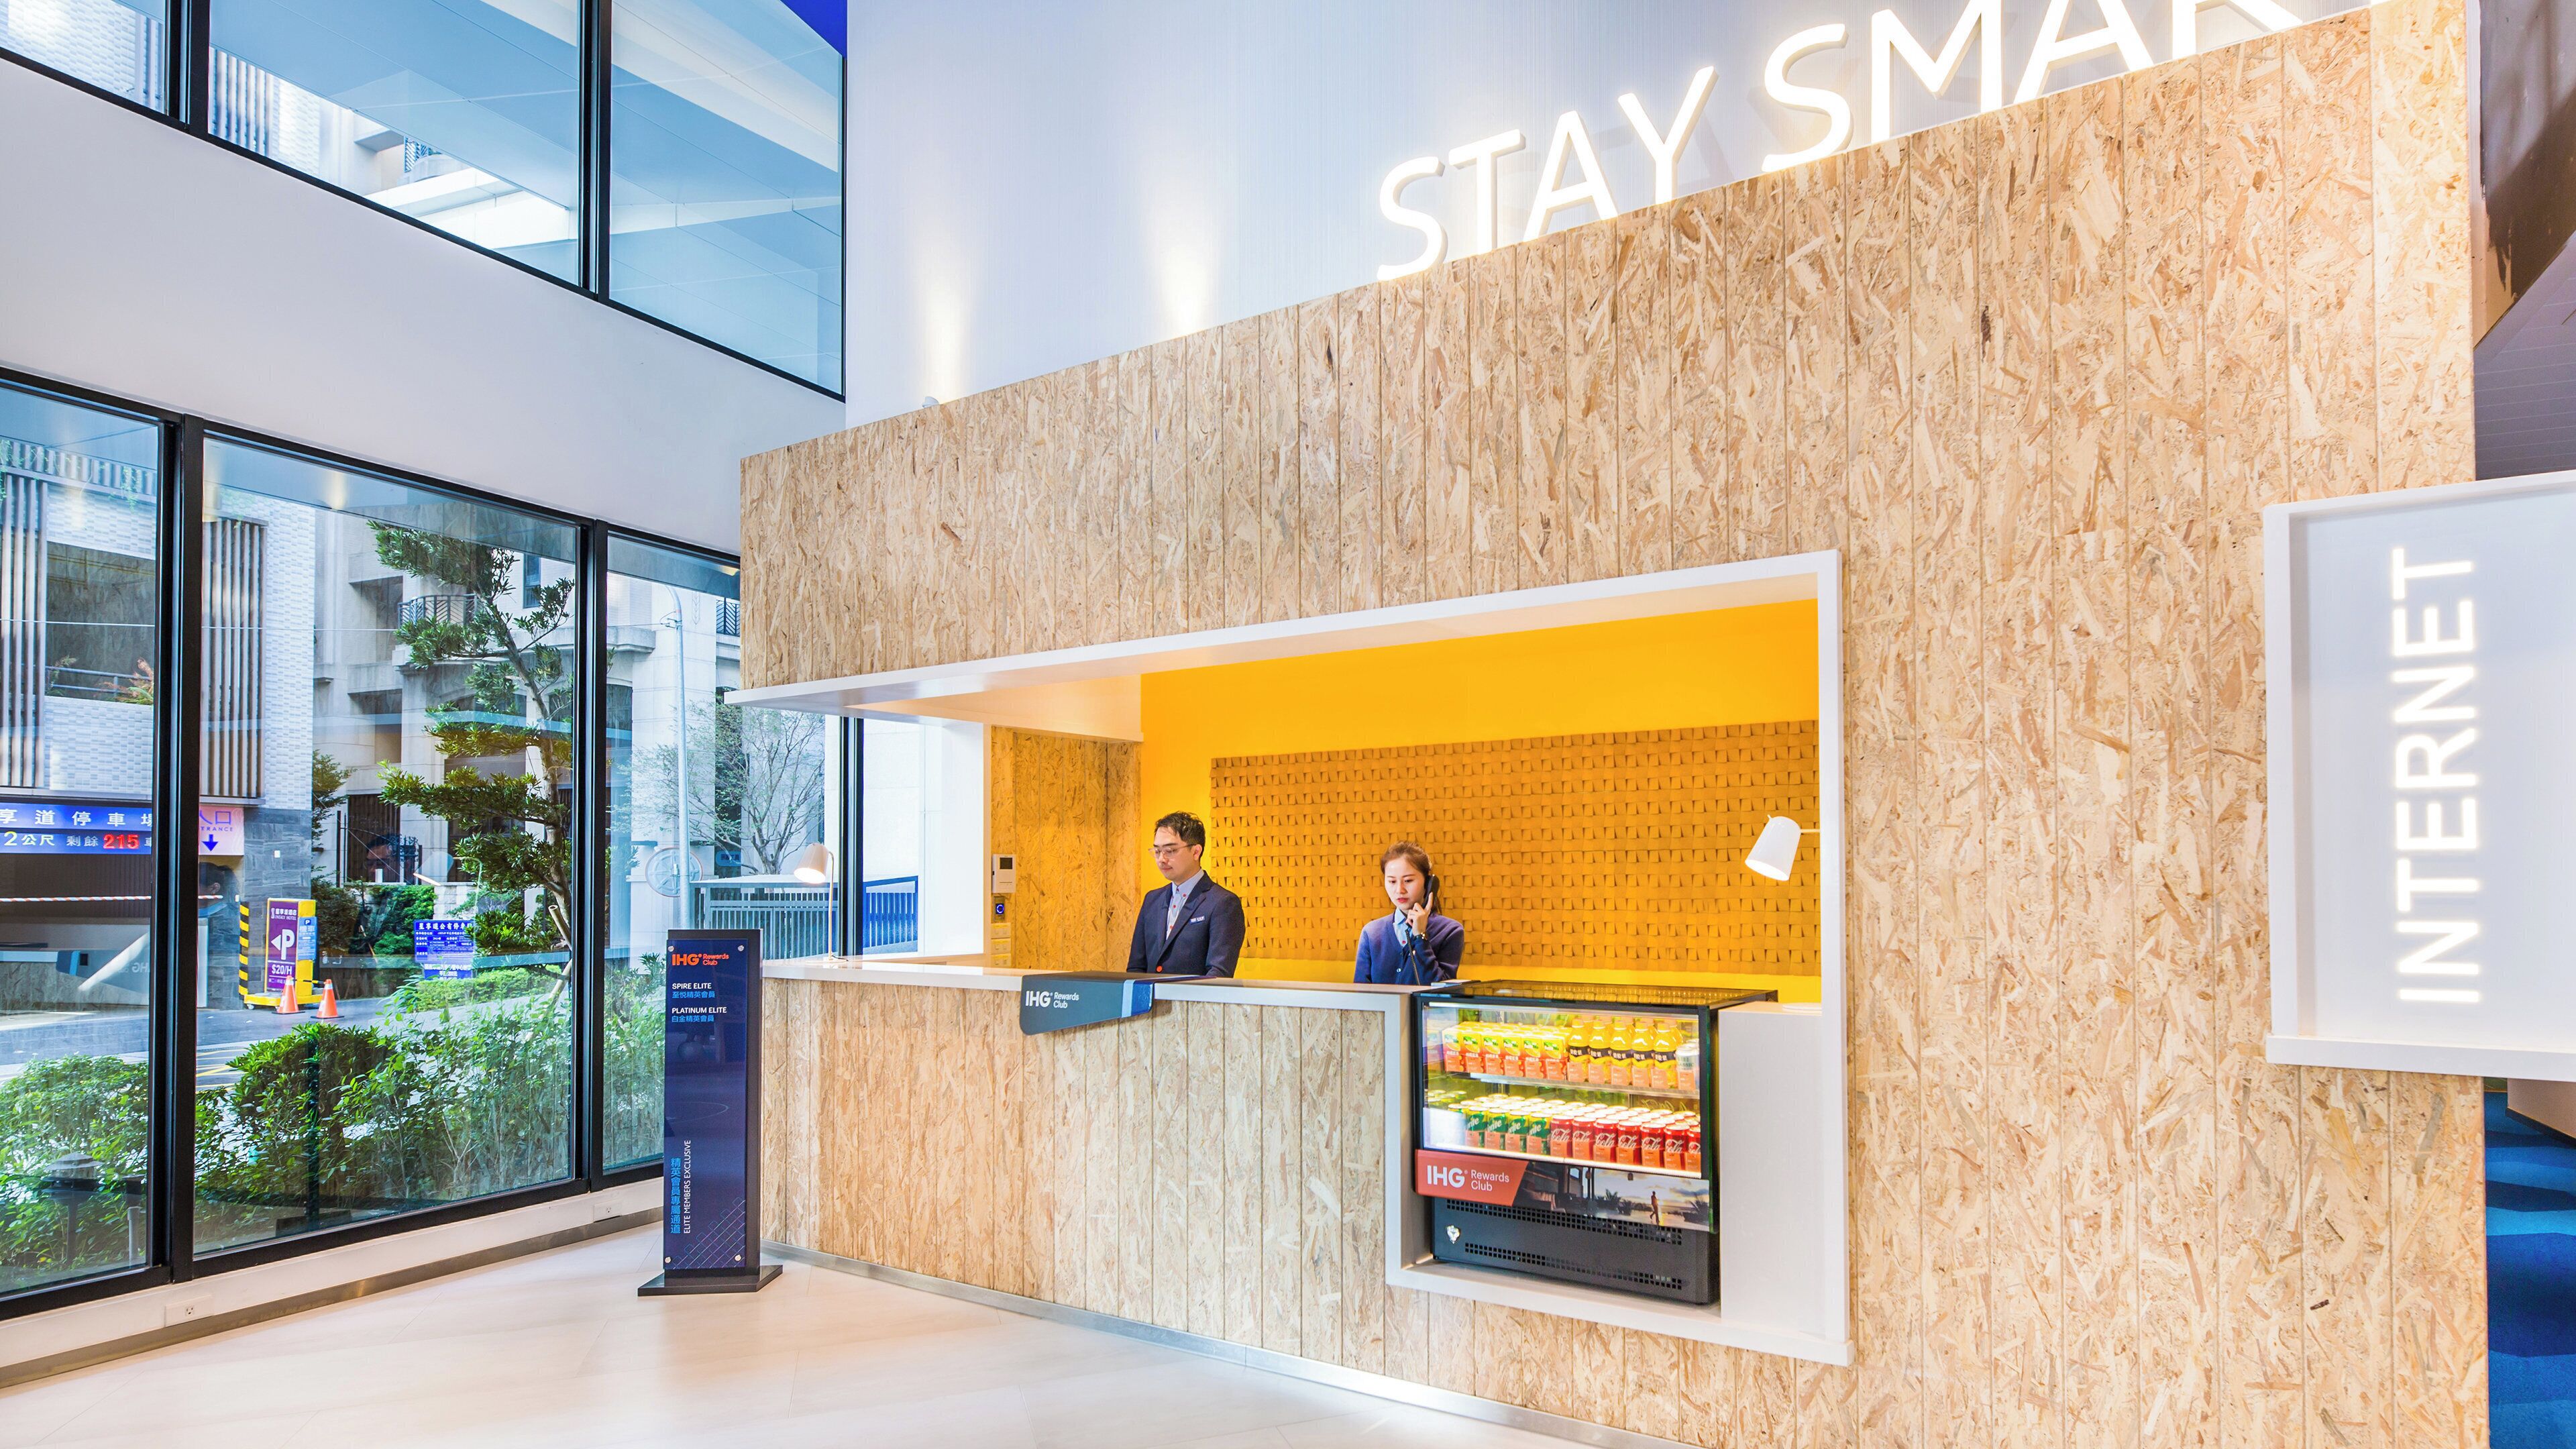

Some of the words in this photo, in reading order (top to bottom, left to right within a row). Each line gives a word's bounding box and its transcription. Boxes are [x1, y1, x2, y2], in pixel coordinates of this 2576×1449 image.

[1377, 66, 1717, 281] STAY
[2392, 547, 2481, 1003] INTERNET
[103, 834, 140, 849] 215
[281, 928, 295, 961] P
[672, 953, 700, 966] IHG
[1025, 990, 1051, 1008] IHG
[1054, 991, 1079, 1001] Rewards
[1053, 1000, 1068, 1008] Club
[1427, 1165, 1465, 1188] IHG
[1470, 1169, 1509, 1183] Rewards
[1470, 1180, 1493, 1191] Club
